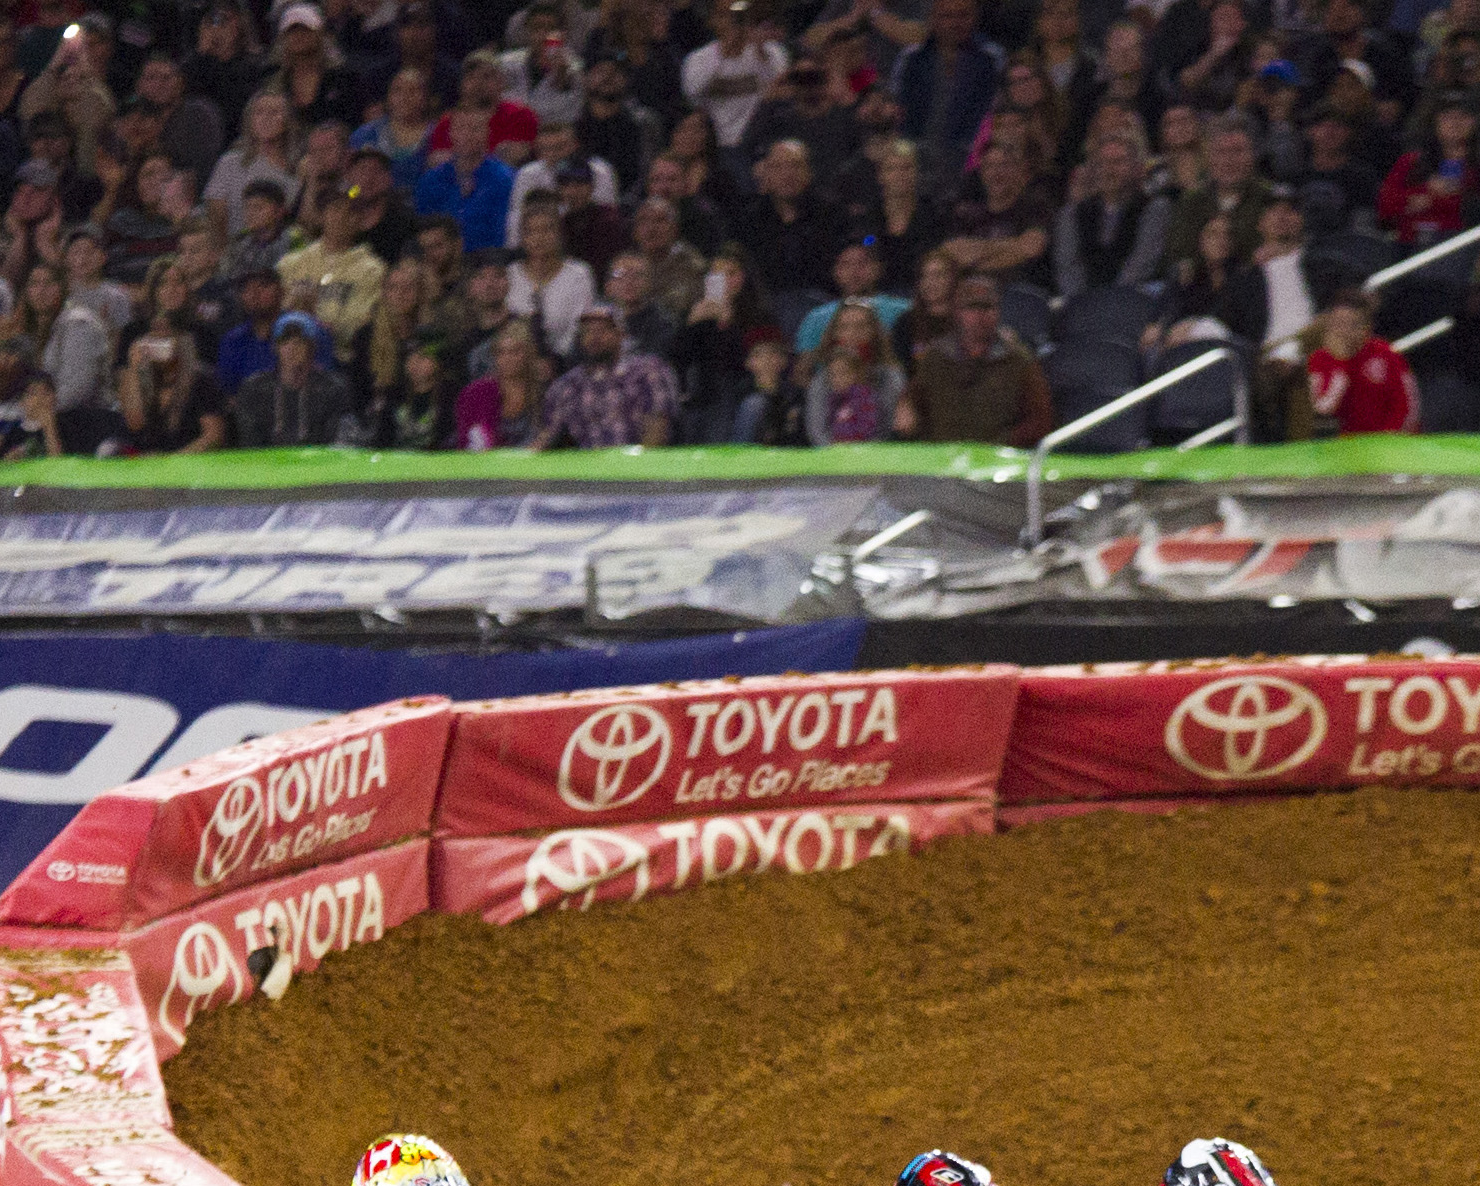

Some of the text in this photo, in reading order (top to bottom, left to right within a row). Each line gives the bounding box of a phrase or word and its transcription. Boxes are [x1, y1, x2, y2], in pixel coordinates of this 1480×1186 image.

[685, 687, 900, 758] TOYOTA
[268, 732, 386, 828] TOYOTA
[674, 759, 892, 804] Let's Go Places
[1347, 742, 1444, 777] Let's
